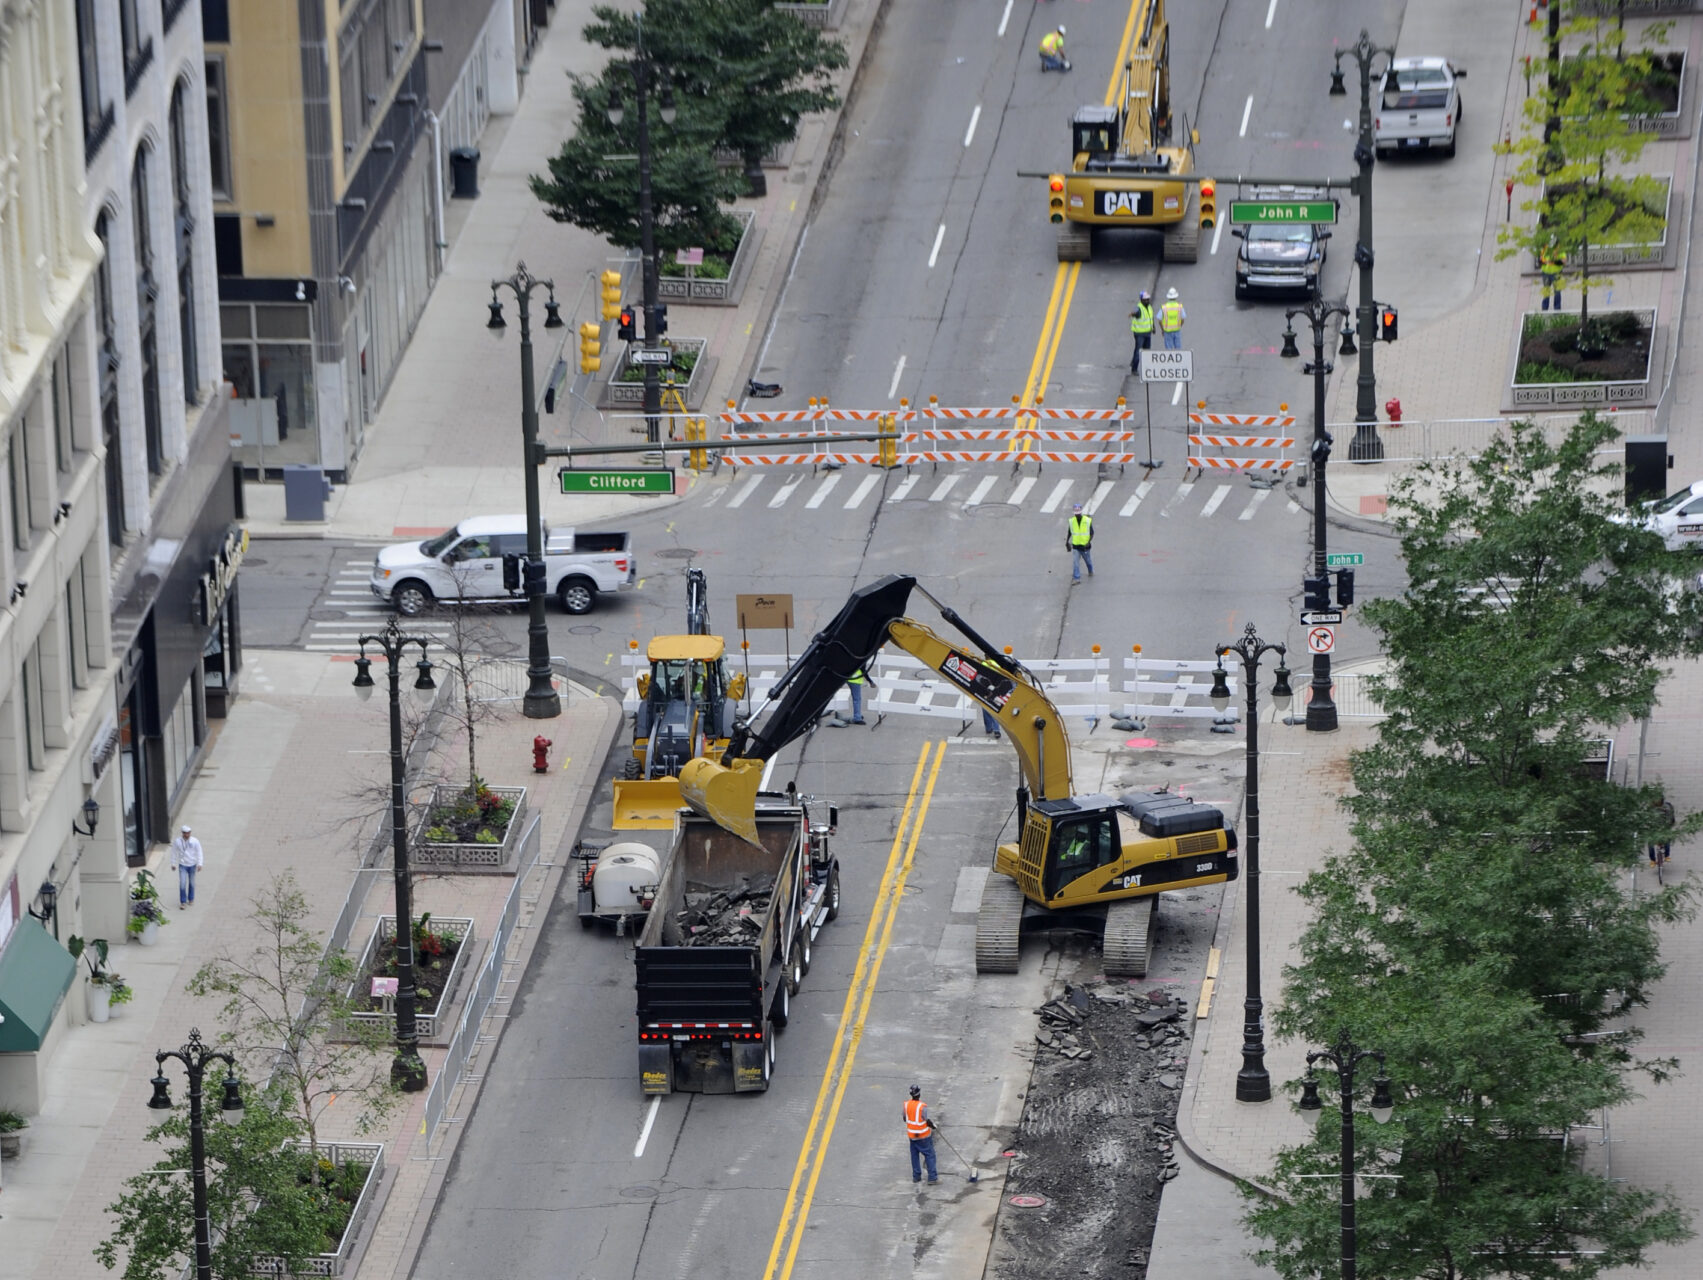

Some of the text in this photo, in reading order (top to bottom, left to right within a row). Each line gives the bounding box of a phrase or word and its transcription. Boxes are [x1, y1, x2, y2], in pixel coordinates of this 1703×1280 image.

[1104, 192, 1141, 216] CAT
[1259, 206, 1308, 218] John R
[1152, 353, 1182, 363] ROAD
[1145, 369, 1189, 378] CLOSED
[589, 476, 645, 488] Clifford
[1332, 555, 1360, 565] John R
[1123, 874, 1142, 888] CAT
